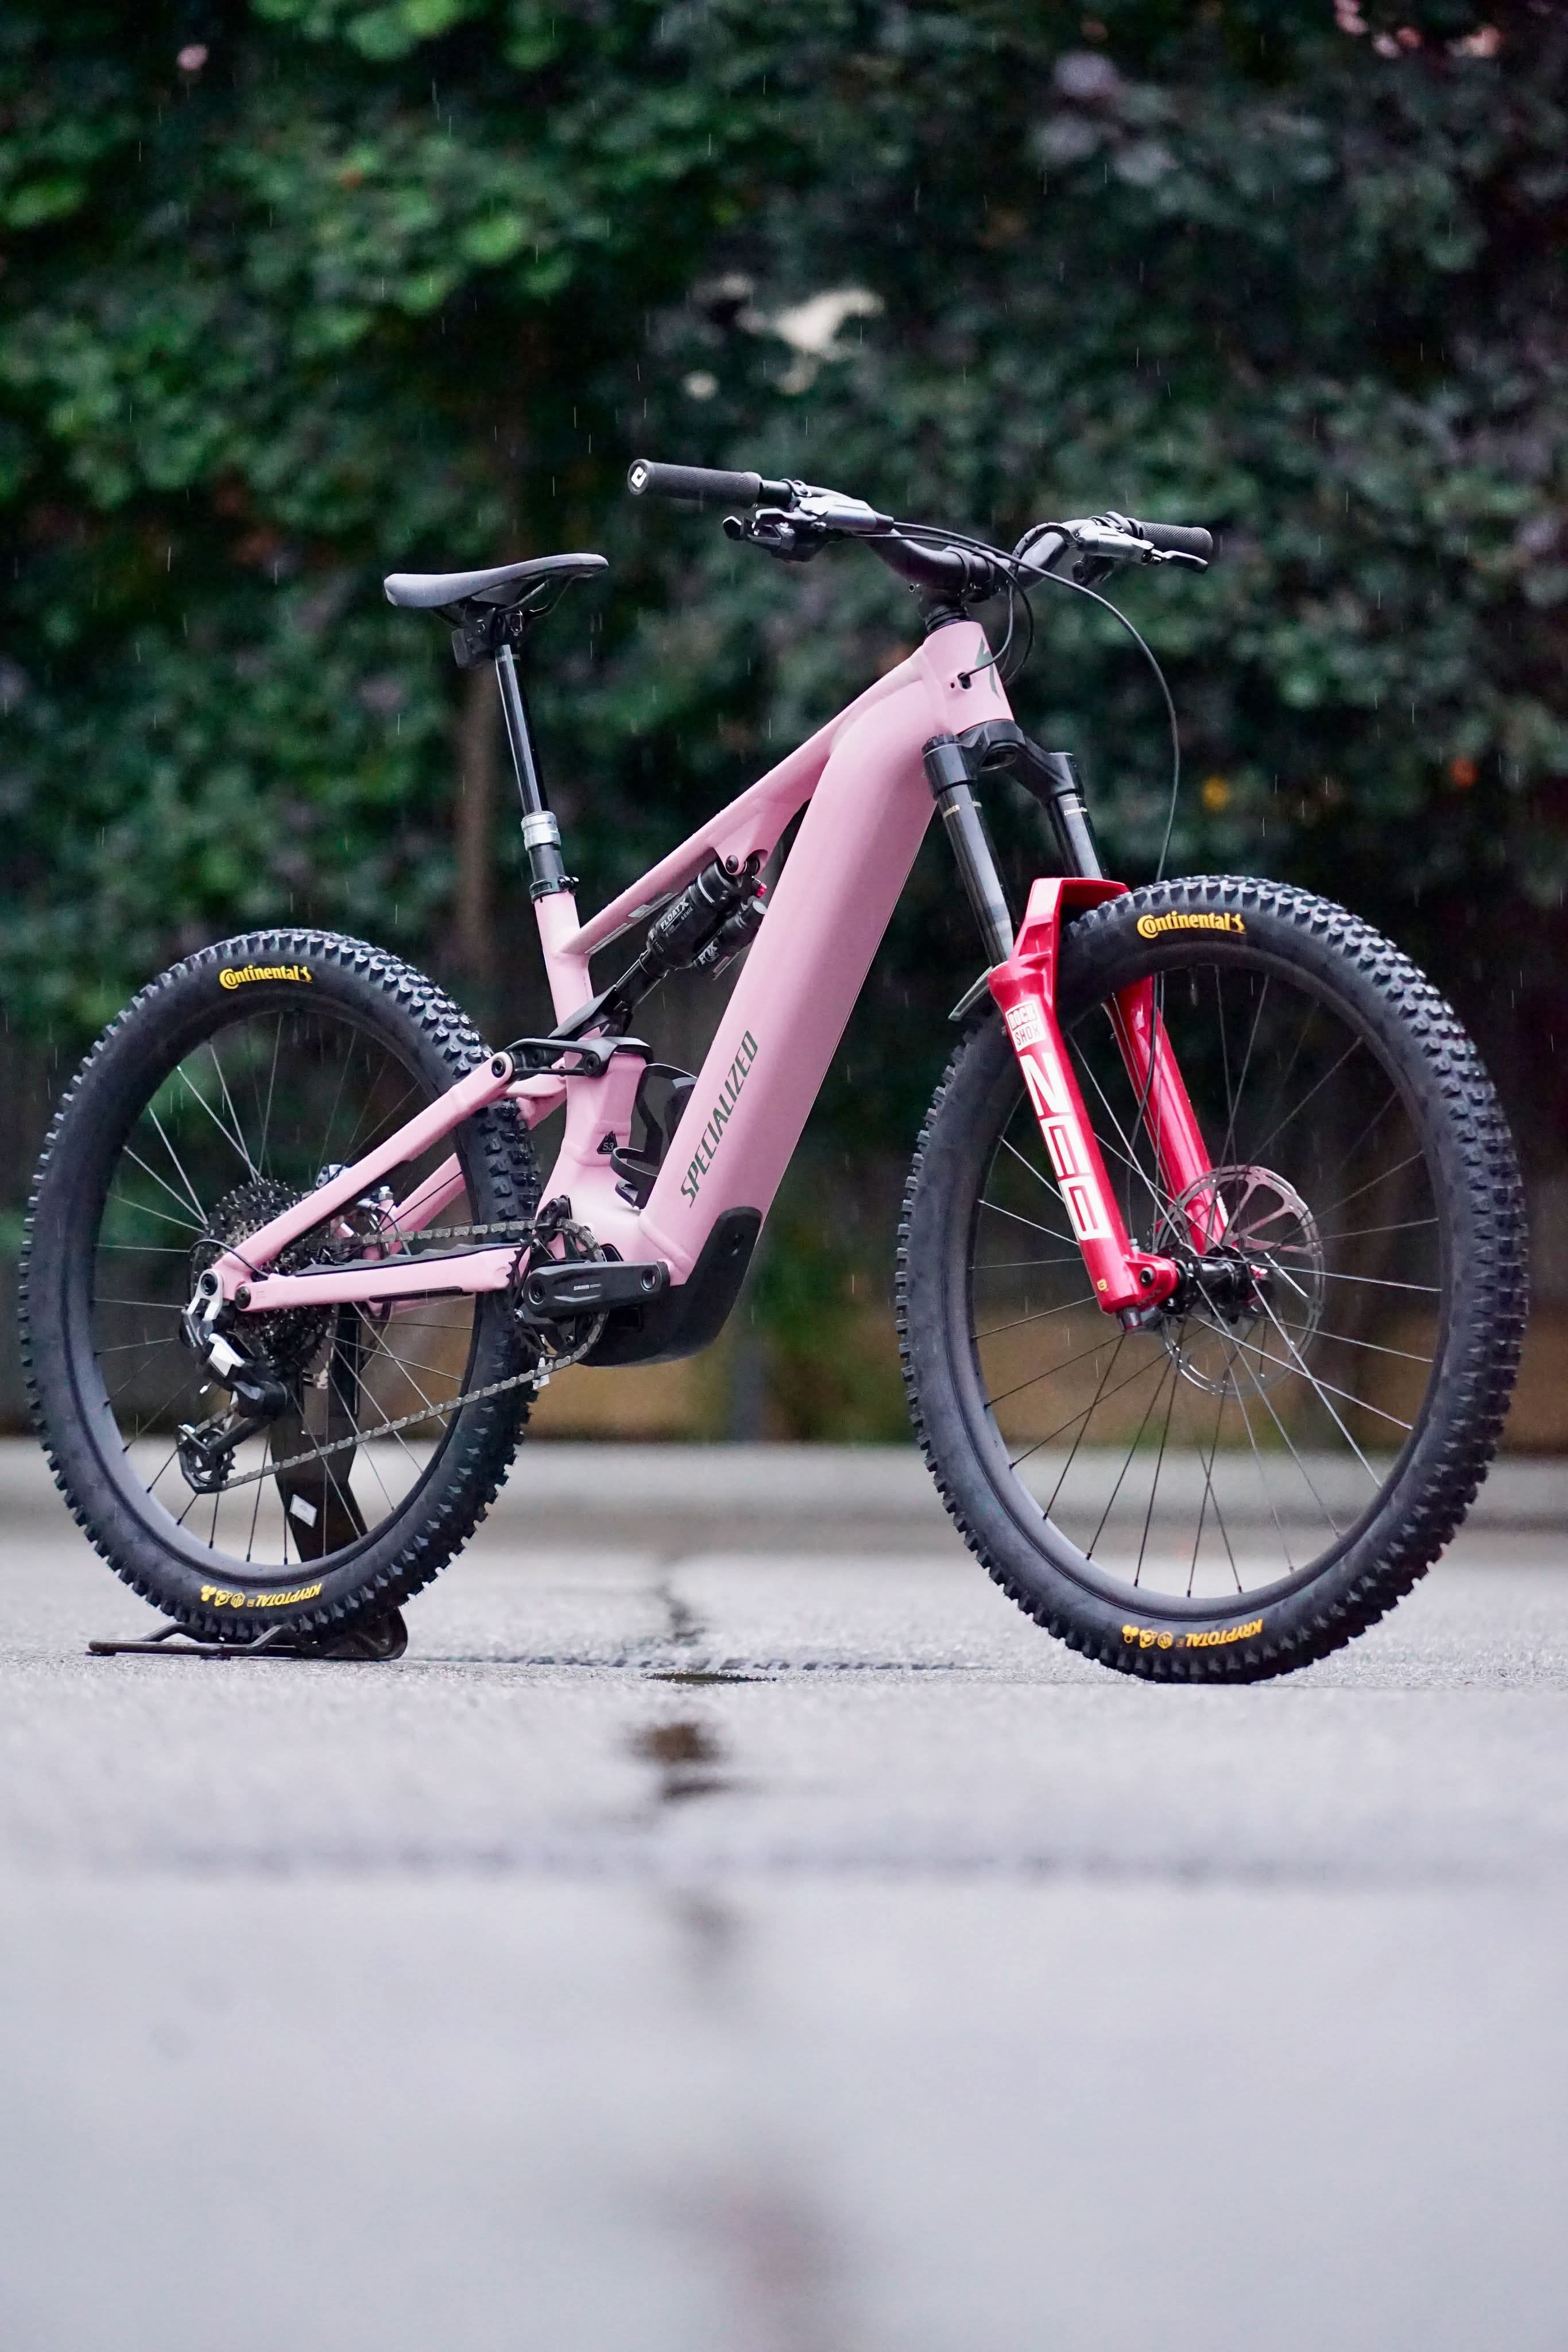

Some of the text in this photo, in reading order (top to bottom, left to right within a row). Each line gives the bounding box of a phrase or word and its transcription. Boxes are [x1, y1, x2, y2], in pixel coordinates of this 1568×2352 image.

[1137, 910, 1230, 939] Continental
[698, 941, 718, 965] FOX
[219, 965, 299, 989] Continental
[681, 1030, 758, 1208] SPECIALIZED
[603, 1142, 614, 1151] S3
[255, 1582, 322, 1607] KRYPTOTAL
[1185, 1619, 1263, 1647] KRYPTOTAL
